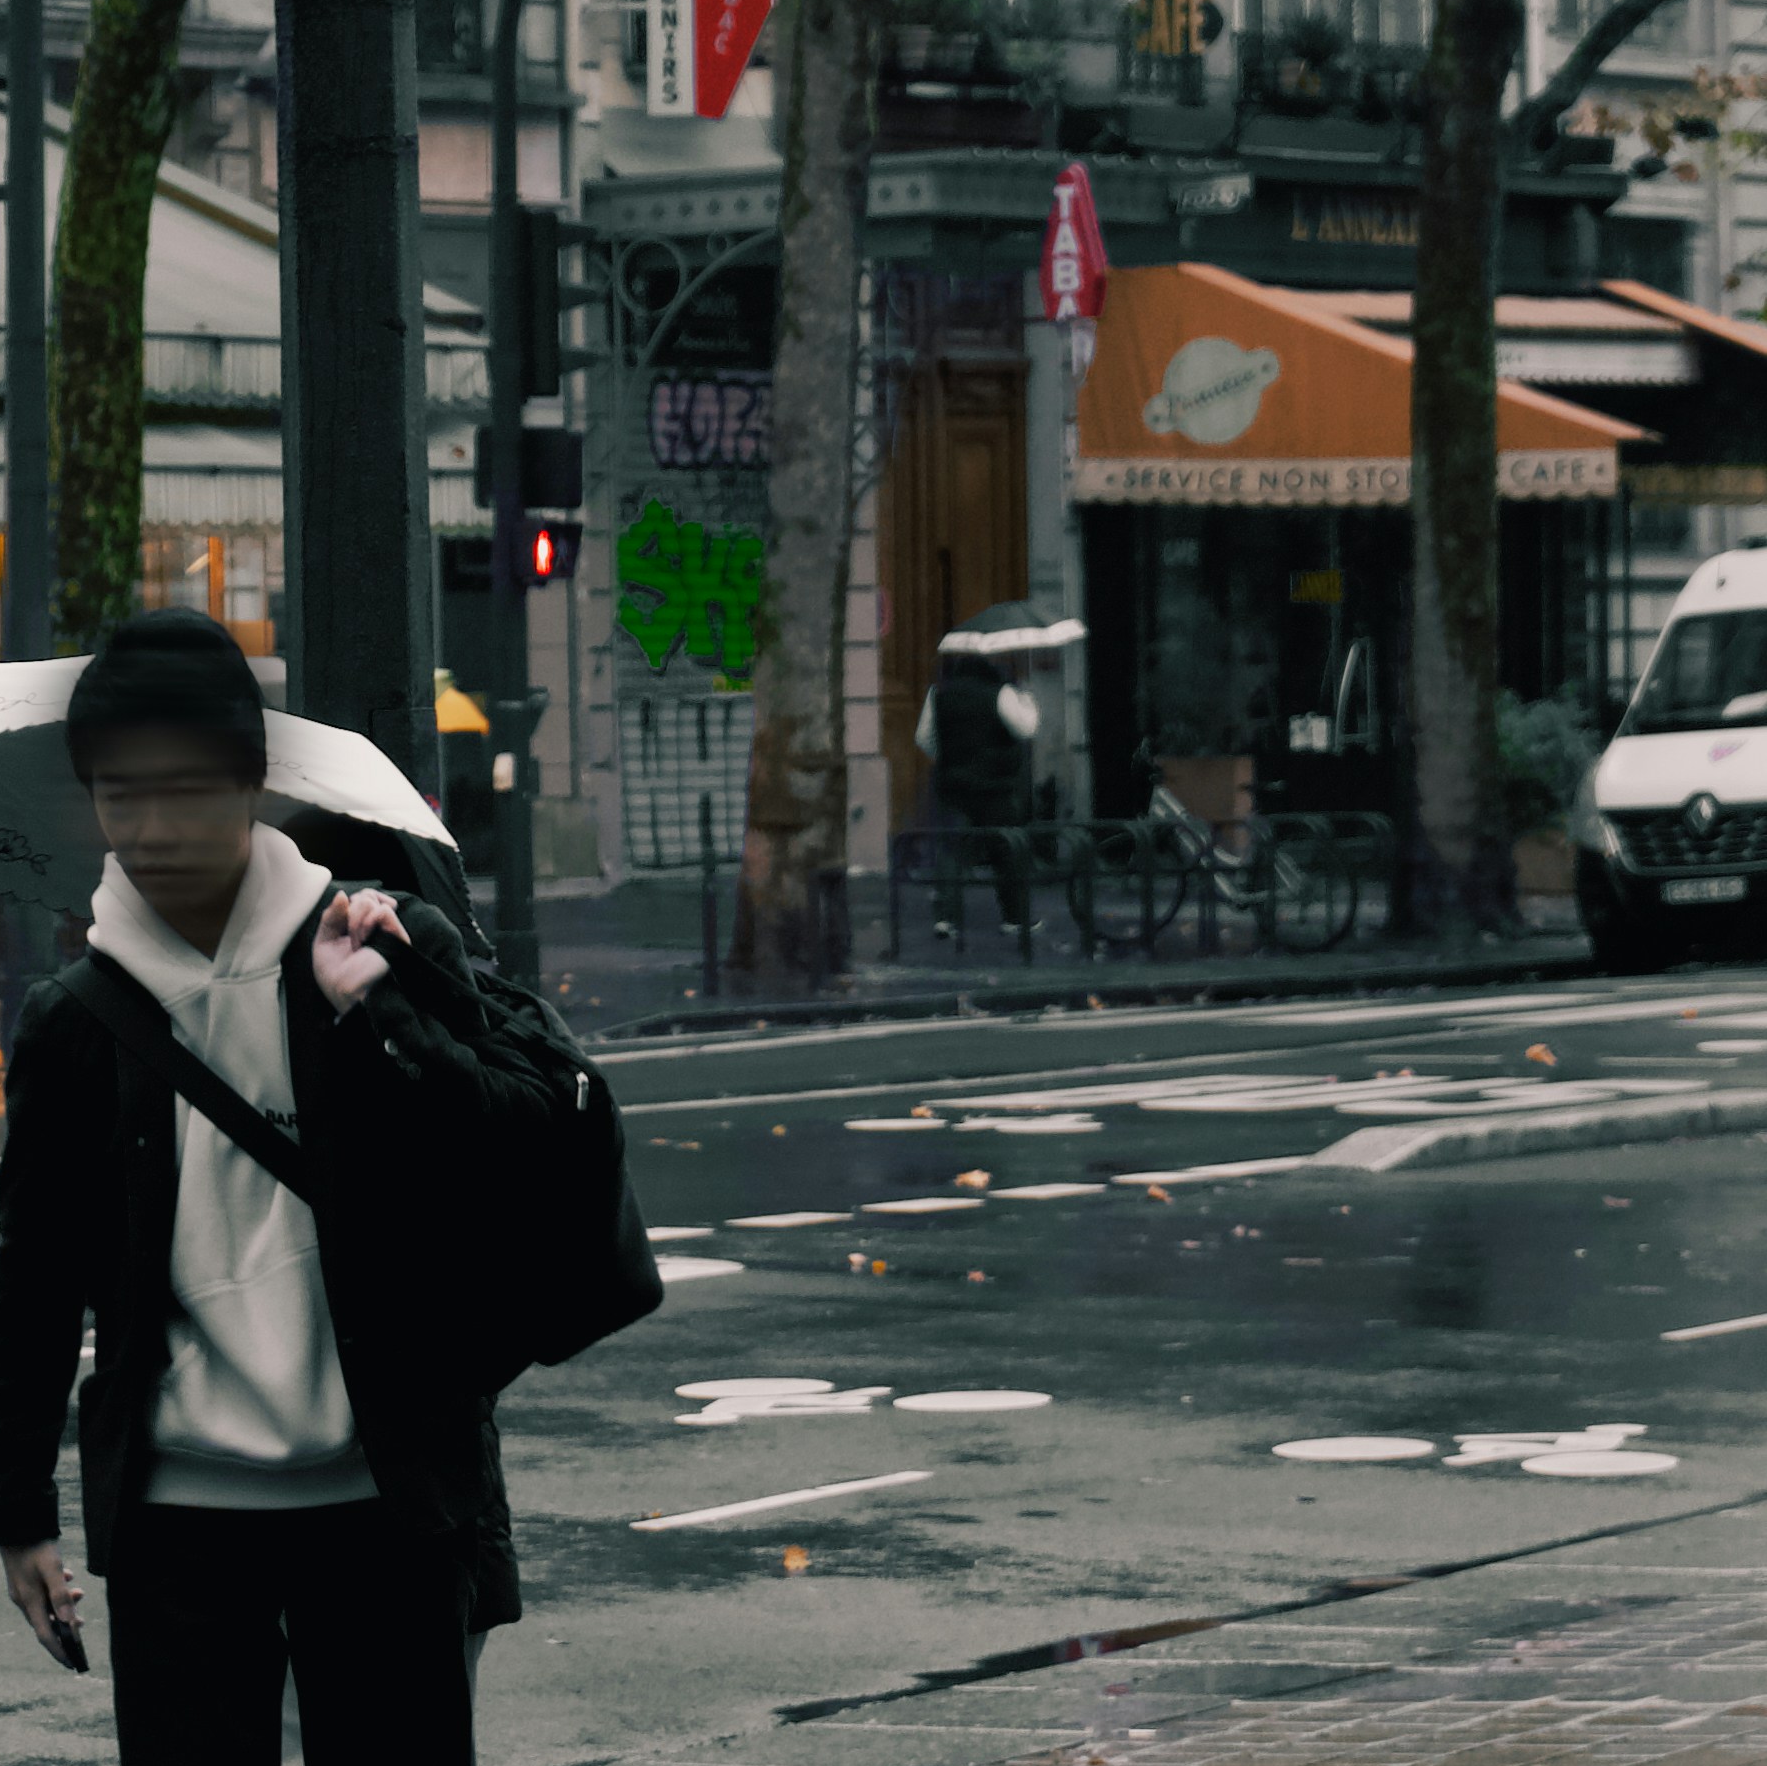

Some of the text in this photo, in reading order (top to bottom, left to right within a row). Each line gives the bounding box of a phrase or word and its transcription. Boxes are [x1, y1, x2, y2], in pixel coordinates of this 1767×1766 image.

[1052, 184, 1081, 321] TABA
[1123, 464, 1410, 491] SERVICE NON STO
